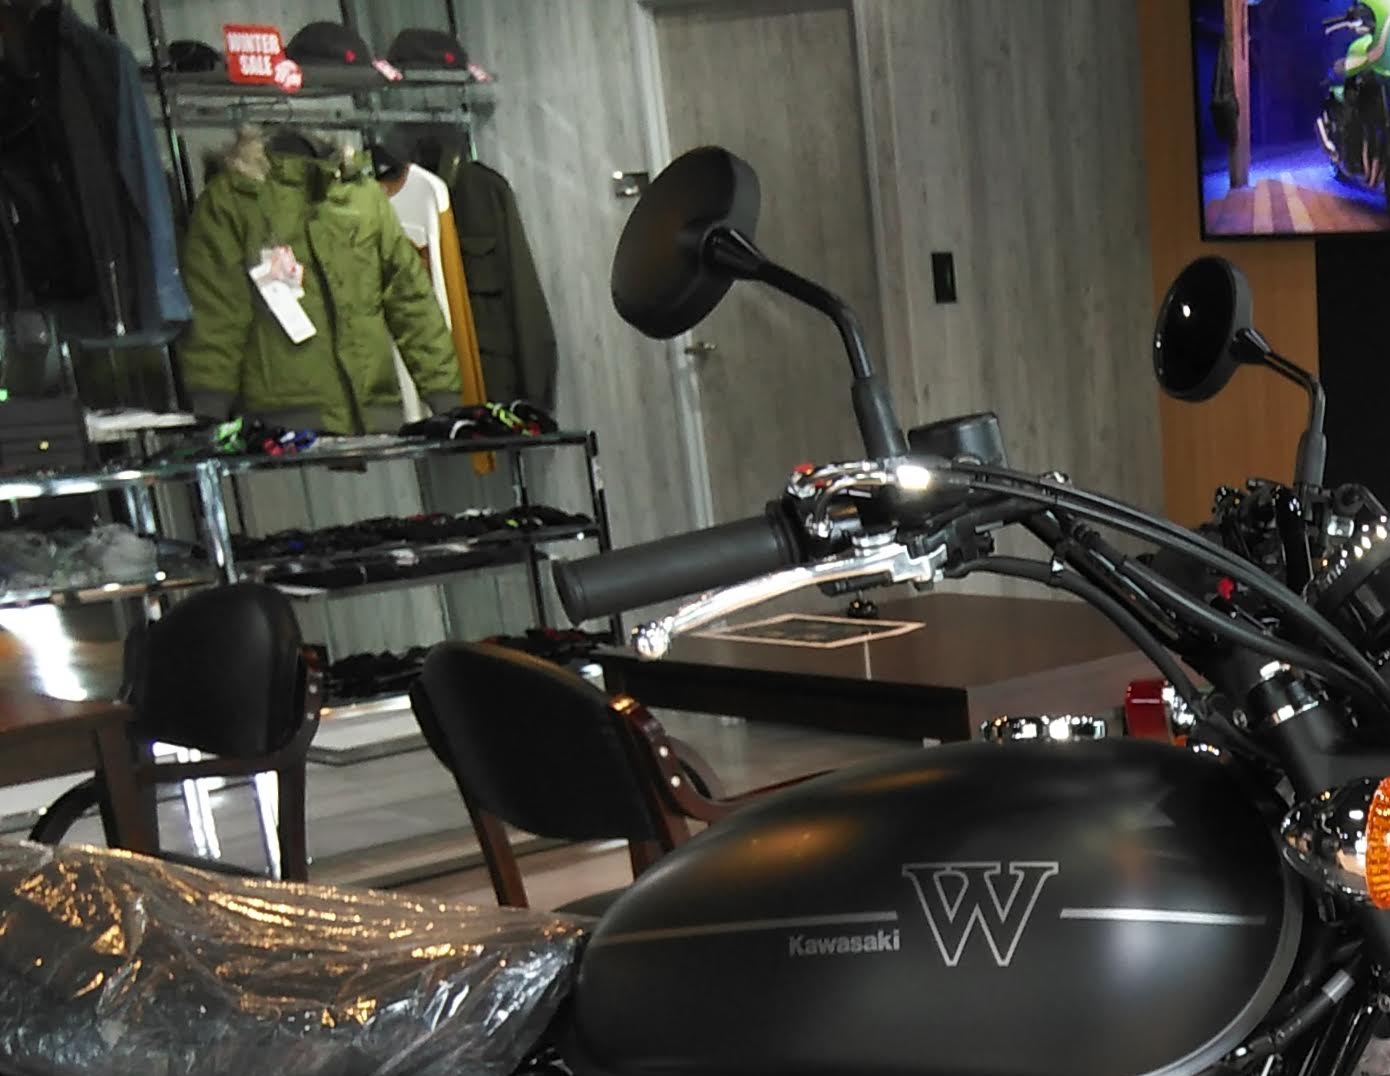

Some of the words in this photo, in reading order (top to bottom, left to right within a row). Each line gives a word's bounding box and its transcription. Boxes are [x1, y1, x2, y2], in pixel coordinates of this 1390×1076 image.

[226, 31, 280, 55] WINTER
[239, 53, 273, 76] SALE
[901, 860, 1059, 967] W
[789, 929, 900, 957] Kawasaki
